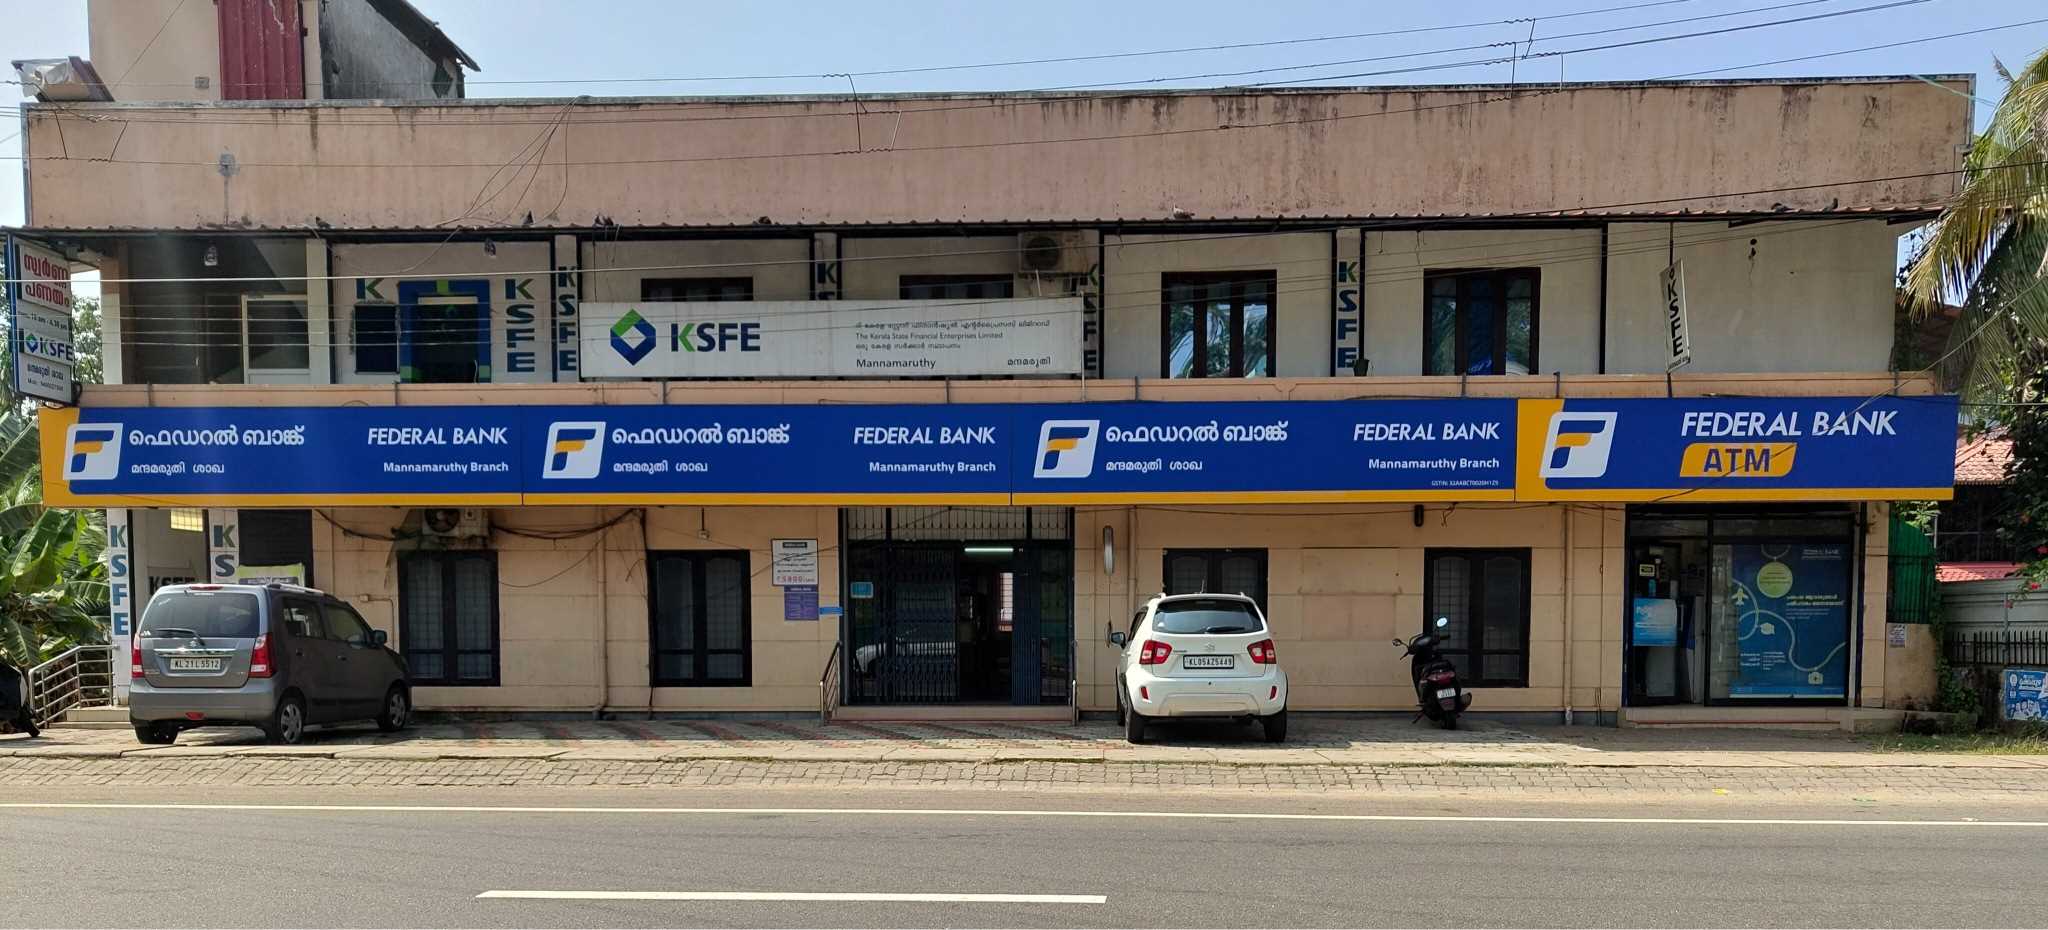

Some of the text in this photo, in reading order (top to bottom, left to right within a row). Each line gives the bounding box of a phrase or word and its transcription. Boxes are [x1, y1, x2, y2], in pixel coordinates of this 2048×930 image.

[558, 266, 577, 371] KSFE
[1337, 261, 1358, 368] KSFE
[1667, 279, 1683, 357] KSFE
[505, 279, 535, 372] KSFE
[671, 322, 760, 352] KSFE
[39, 336, 74, 361] KSFE
[856, 358, 936, 369] Mannamaruthy
[612, 423, 790, 444] ഫെഡറൽ ബാങ്ക്
[1106, 421, 1288, 442] ഫെഡറൽ ബാങ്ക്
[1353, 422, 1500, 441] FEDERAL BANK
[1681, 410, 1898, 437] FEDERAL BANK
[129, 425, 305, 446] ഫെഡറൽ ബാങ്ക്
[367, 427, 508, 445] FEDERAL BANK
[854, 427, 996, 444] FEDERAL BANK
[192, 463, 225, 474] ശാഖ
[384, 462, 509, 474] Mannamaruthy Branch
[676, 462, 708, 472] ശാഖ
[869, 462, 996, 474] Mannamaruthy Branch
[1169, 460, 1203, 471] ശാഖ
[1368, 458, 1500, 471] Mannamaruthy Branch
[1703, 448, 1770, 472] ATM
[111, 525, 129, 635] KSFE
